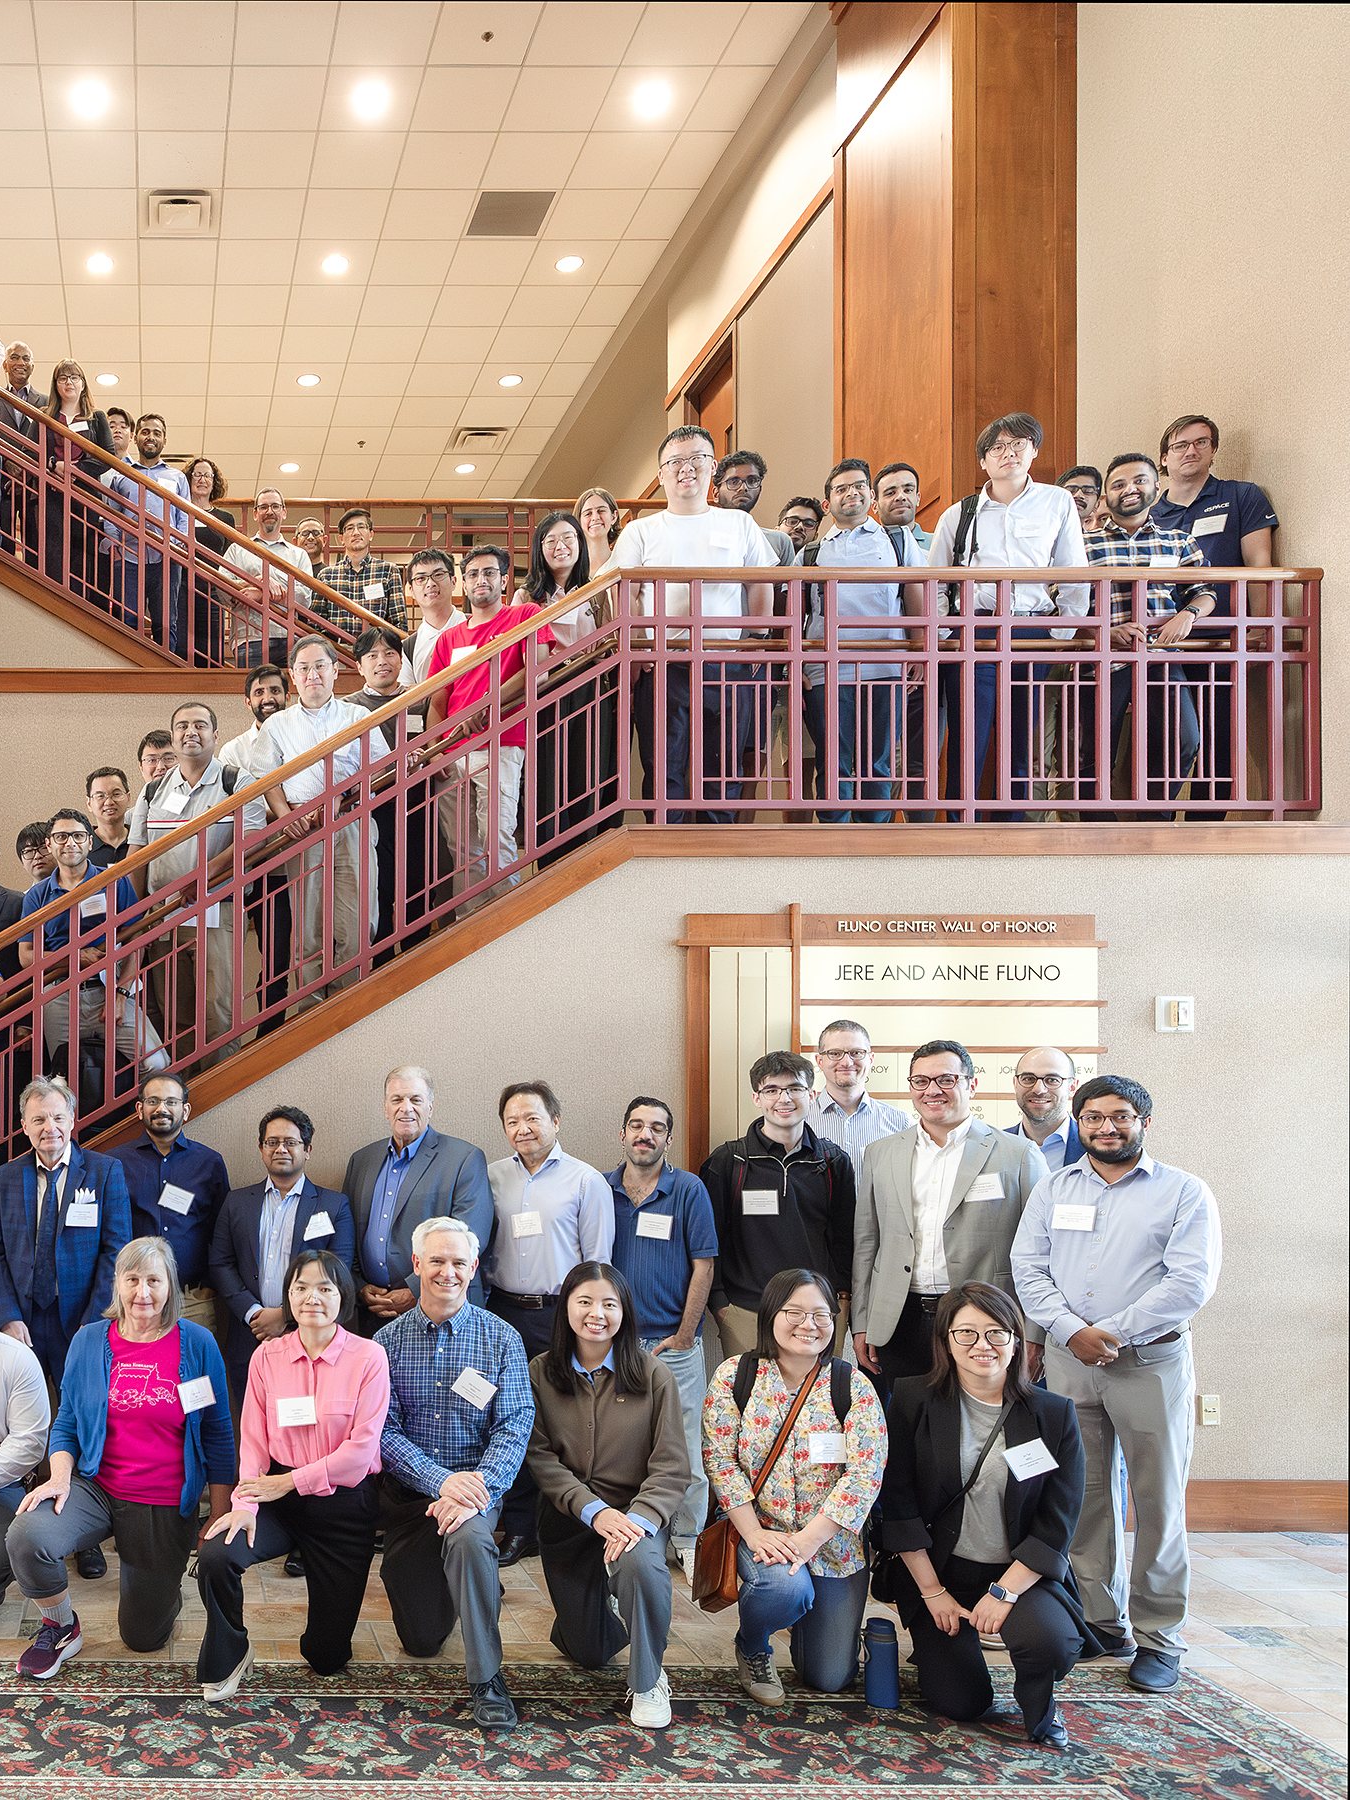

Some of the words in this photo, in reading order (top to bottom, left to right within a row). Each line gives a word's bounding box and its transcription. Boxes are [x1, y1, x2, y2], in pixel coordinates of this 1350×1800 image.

[837, 920, 882, 933] FLUNO
[886, 920, 937, 933] CENTER
[941, 920, 977, 933] WALL
[981, 920, 1001, 933] OF
[1005, 921, 1058, 934] HONOR
[835, 965, 874, 981] JERE
[881, 965, 925, 981] AND
[932, 965, 989, 981] ANNE
[996, 965, 1061, 981] FLUNO
[999, 1066, 1017, 1075] JOH
